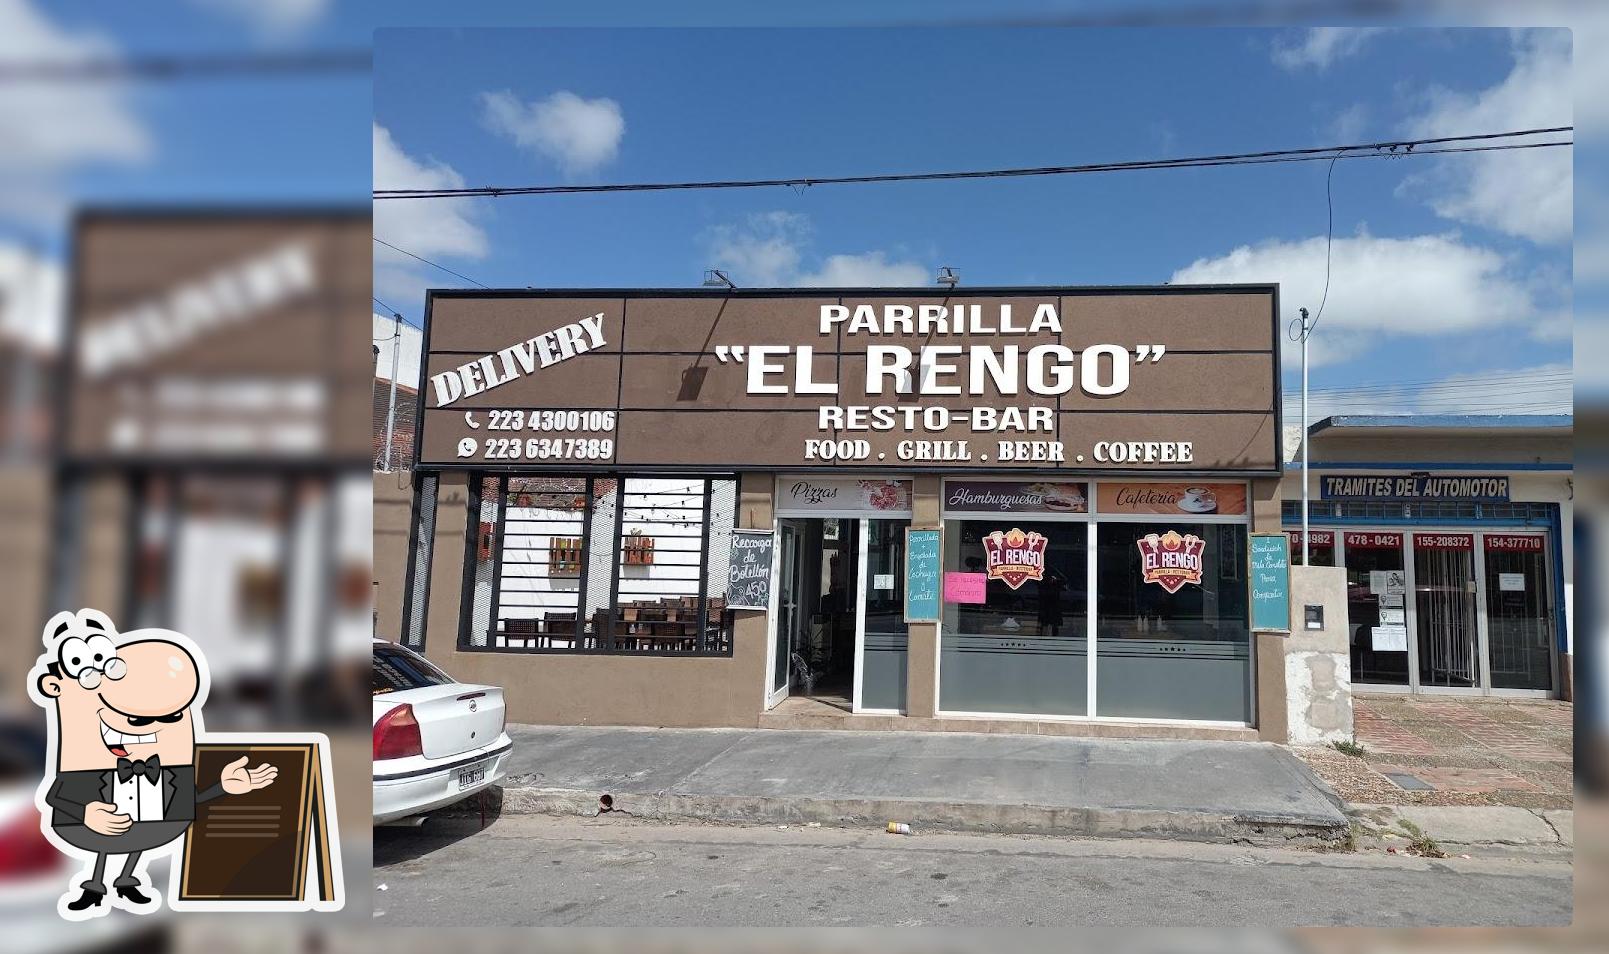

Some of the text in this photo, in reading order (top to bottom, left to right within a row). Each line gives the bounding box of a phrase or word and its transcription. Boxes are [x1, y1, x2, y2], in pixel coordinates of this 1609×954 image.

[818, 303, 1063, 334] PARRILLA
[430, 312, 608, 408] DELIVERY
[487, 410, 615, 431] 223 4300106
[818, 405, 1054, 431] RESTO-BAR
[484, 438, 613, 460] 223 6347389
[804, 439, 871, 460] FOOD
[896, 440, 971, 461] GRILL
[997, 440, 1064, 462] BEER
[1093, 441, 1193, 463] COFFEE
[790, 481, 838, 504] Pizzas
[1116, 486, 1178, 507] Cafetería
[1326, 477, 1508, 498] TRAMITES DEL AUTOMOTOR
[949, 487, 1044, 510] Hamburguesas
[1416, 536, 1470, 547] 155-208372
[1487, 537, 1541, 548] 154-377710
[743, 549, 757, 563] de
[991, 549, 1041, 567] EL RENGO
[1146, 552, 1198, 570] EL RENGO
